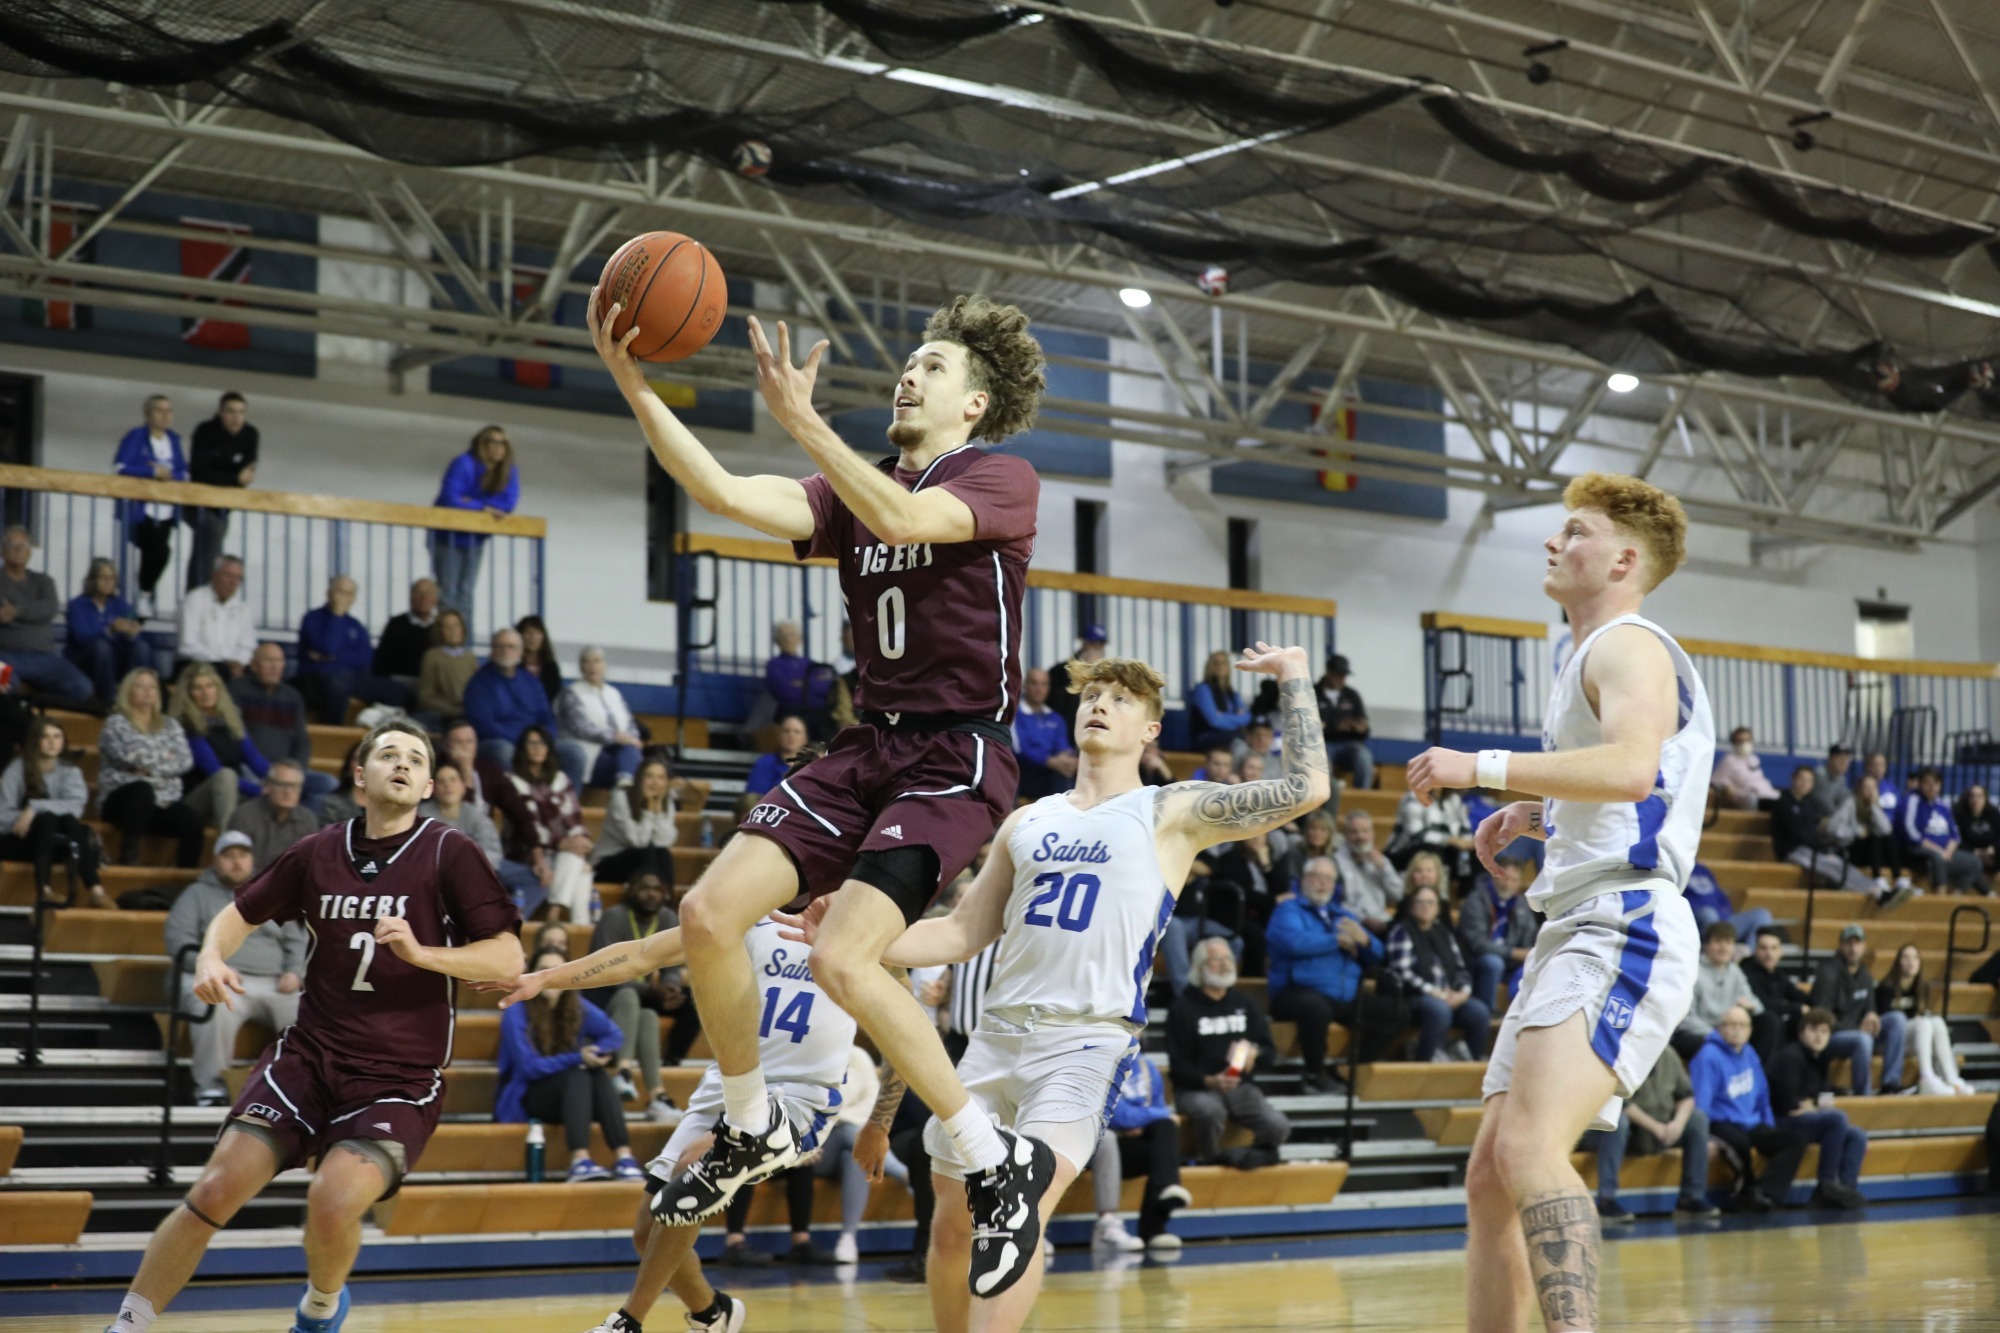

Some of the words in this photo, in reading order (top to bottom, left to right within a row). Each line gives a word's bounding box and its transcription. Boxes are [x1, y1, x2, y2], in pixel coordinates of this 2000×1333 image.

[610, 246, 646, 302] EGACY
[854, 543, 933, 576] IGERS
[877, 586, 906, 660] 0
[1033, 832, 1112, 863] Saints
[320, 895, 410, 919] TIGERS
[1024, 872, 1102, 933] 20
[349, 931, 376, 992] 2
[764, 948, 815, 983] Sain
[759, 986, 815, 1044] 14
